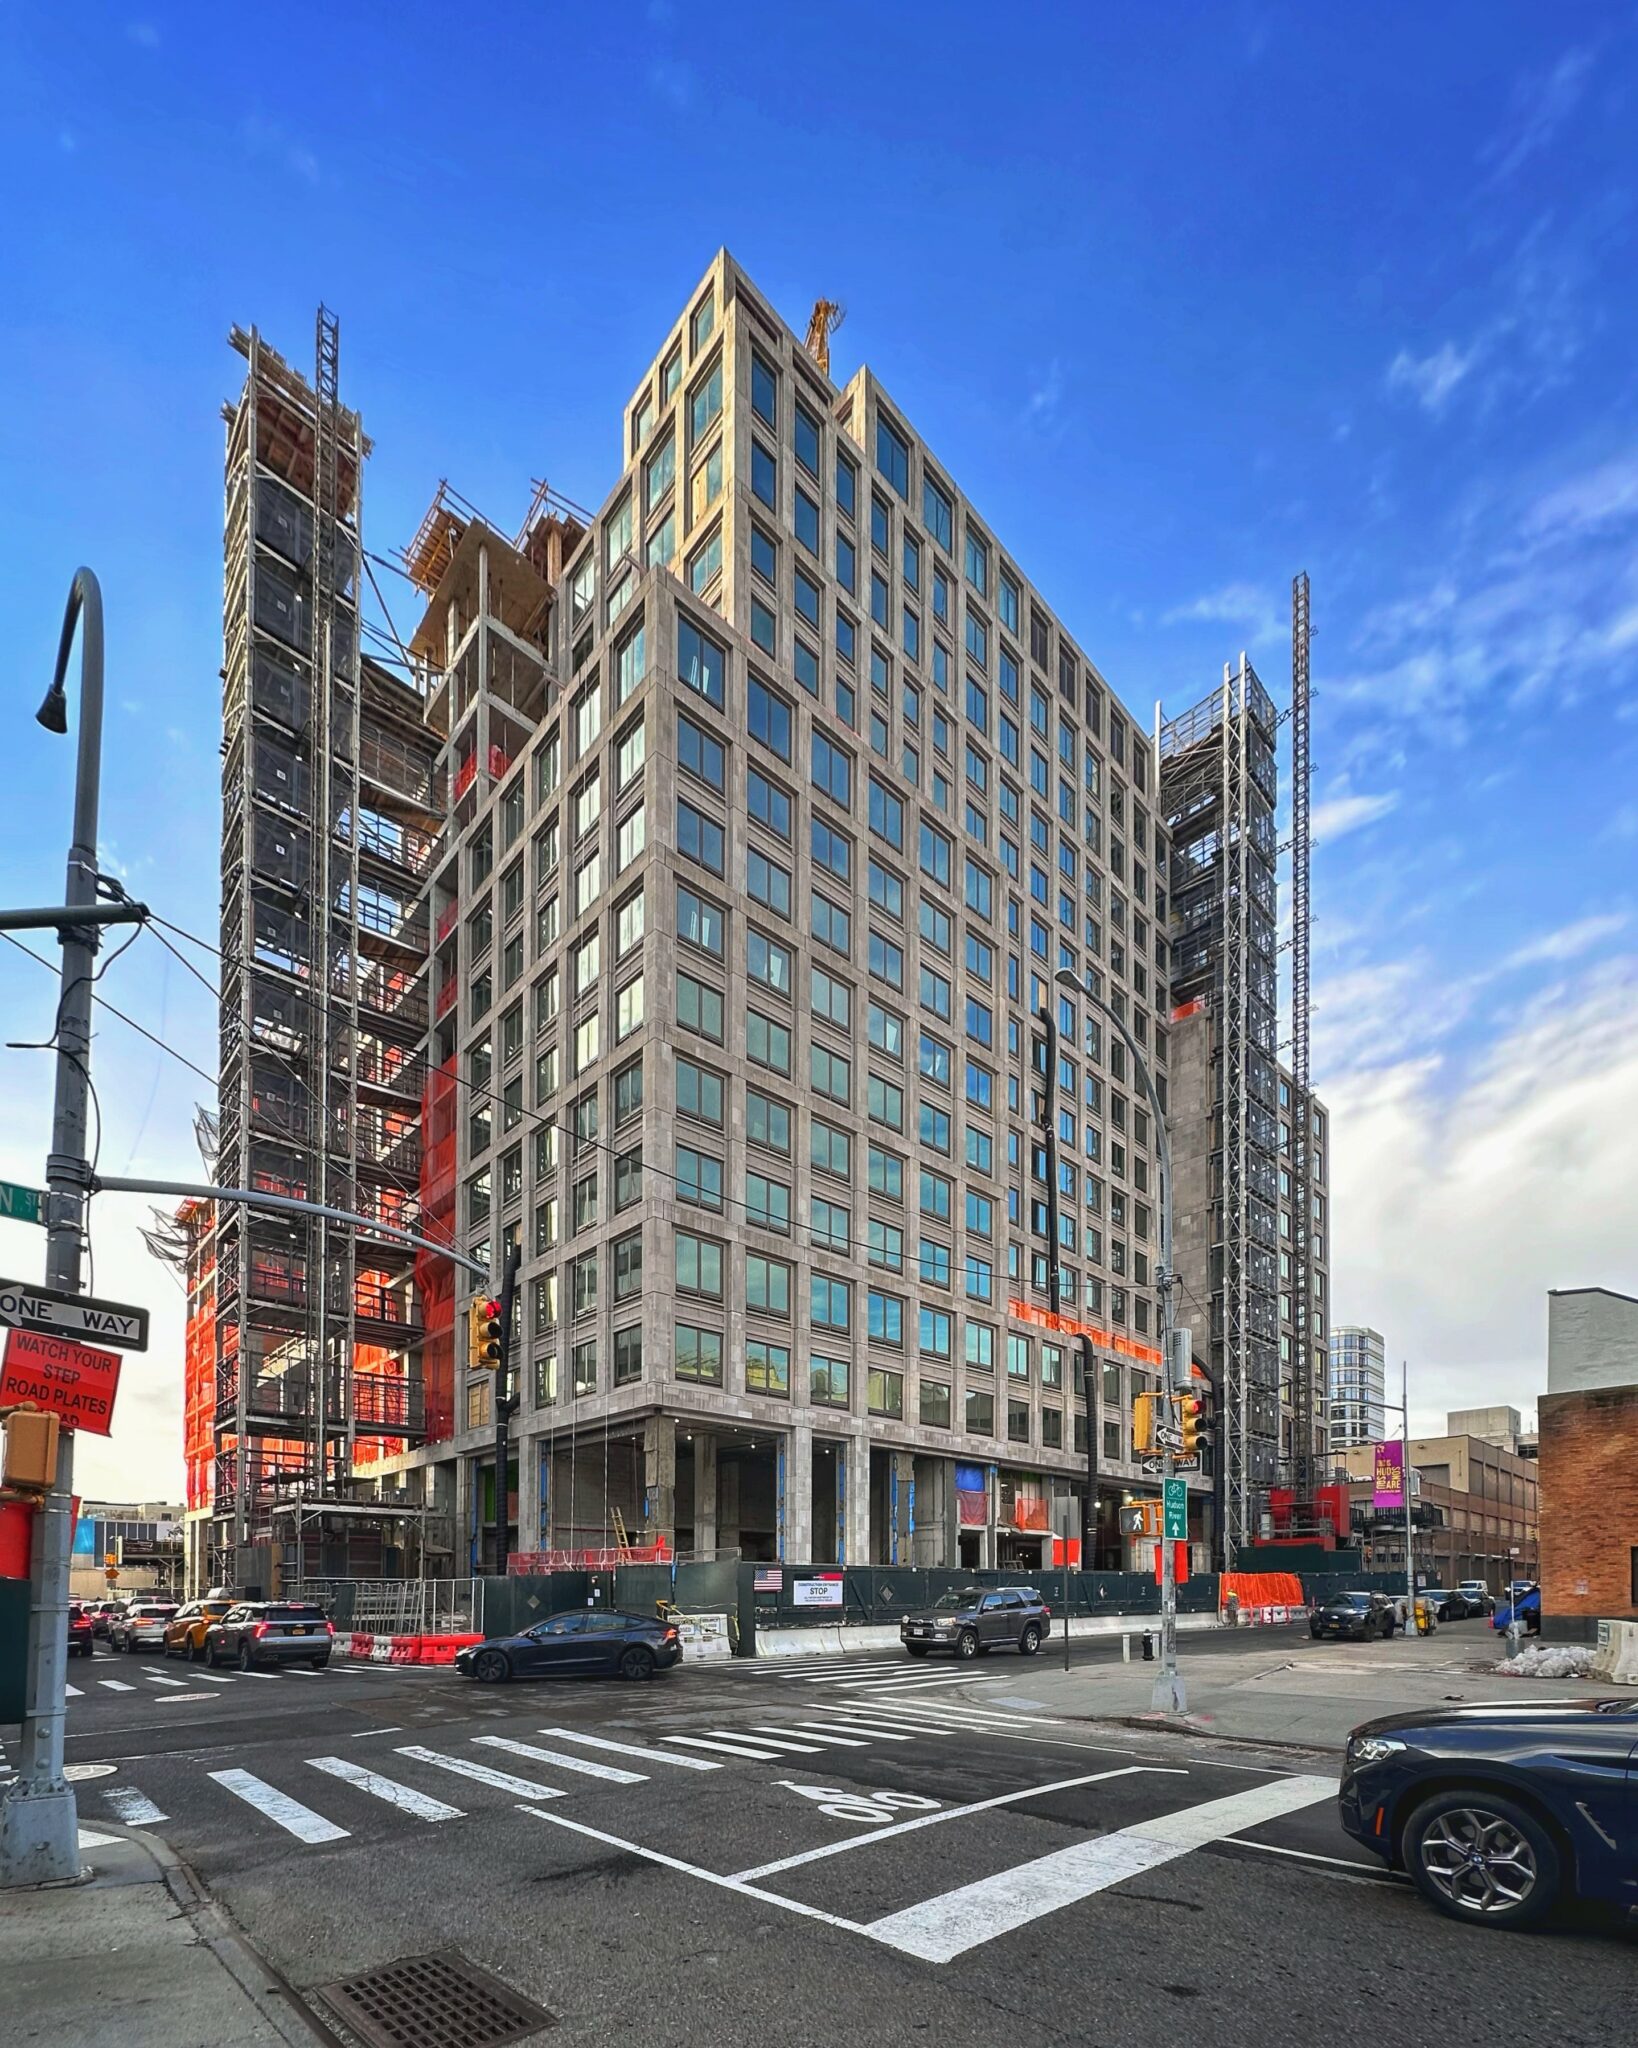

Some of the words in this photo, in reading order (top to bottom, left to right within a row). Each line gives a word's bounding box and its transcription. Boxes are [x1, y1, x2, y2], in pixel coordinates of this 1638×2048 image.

[0, 1294, 53, 1321] ONE
[82, 1310, 134, 1335] WAY
[16, 1333, 69, 1361] WATCH
[73, 1349, 112, 1373] YOUR
[43, 1363, 81, 1385] STEP
[6, 1376, 50, 1401] ROAD
[53, 1388, 108, 1416] PLATES
[1160, 1431, 1173, 1442] ONE
[1376, 1467, 1392, 1476] HUD
[1166, 1500, 1184, 1509] Hudson
[1169, 1511, 1182, 1520] River
[809, 1587, 828, 1595] STOP
